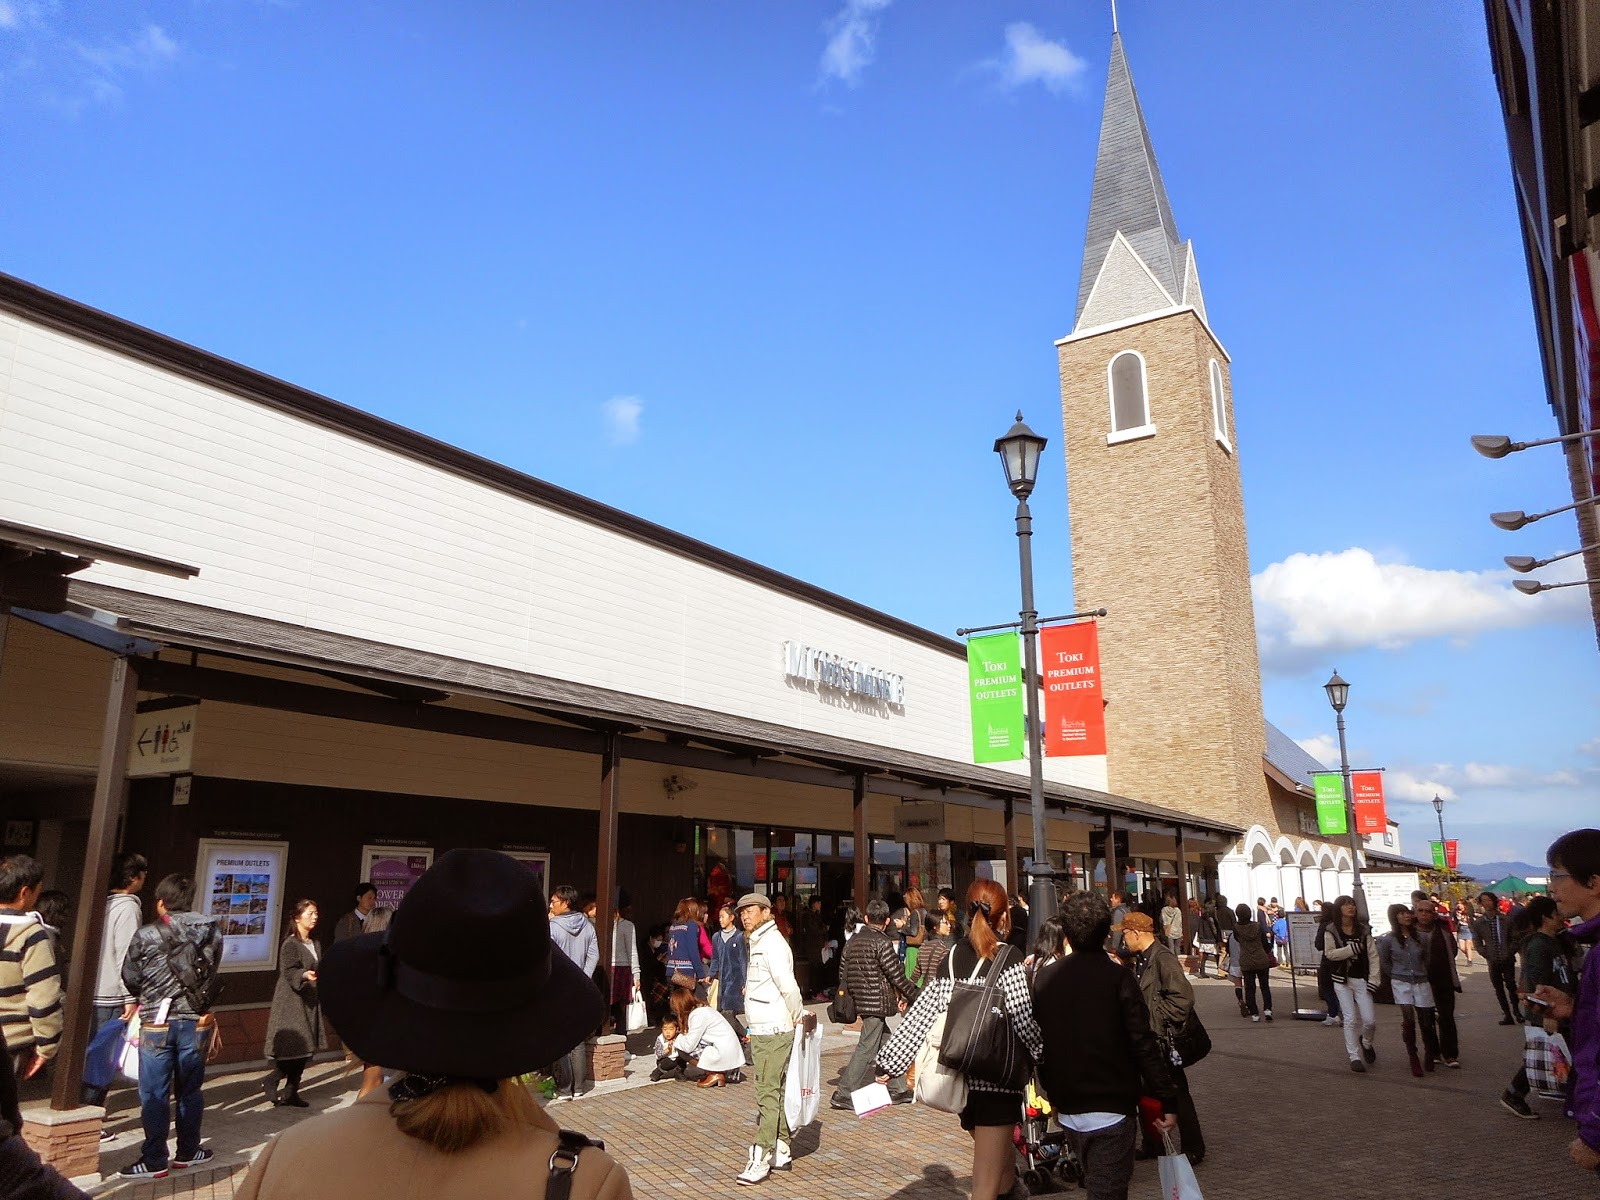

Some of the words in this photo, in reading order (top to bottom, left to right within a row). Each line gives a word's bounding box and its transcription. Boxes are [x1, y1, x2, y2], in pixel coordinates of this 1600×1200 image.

[1056, 651, 1083, 663] TOKI
[982, 661, 1007, 672] TOKI
[1047, 666, 1094, 678] PREMIUM
[974, 675, 1017, 687] PREMIUM
[1050, 680, 1095, 692] OUTLETS
[976, 688, 1017, 700] OUTLETS
[376, 889, 405, 900] OWER
